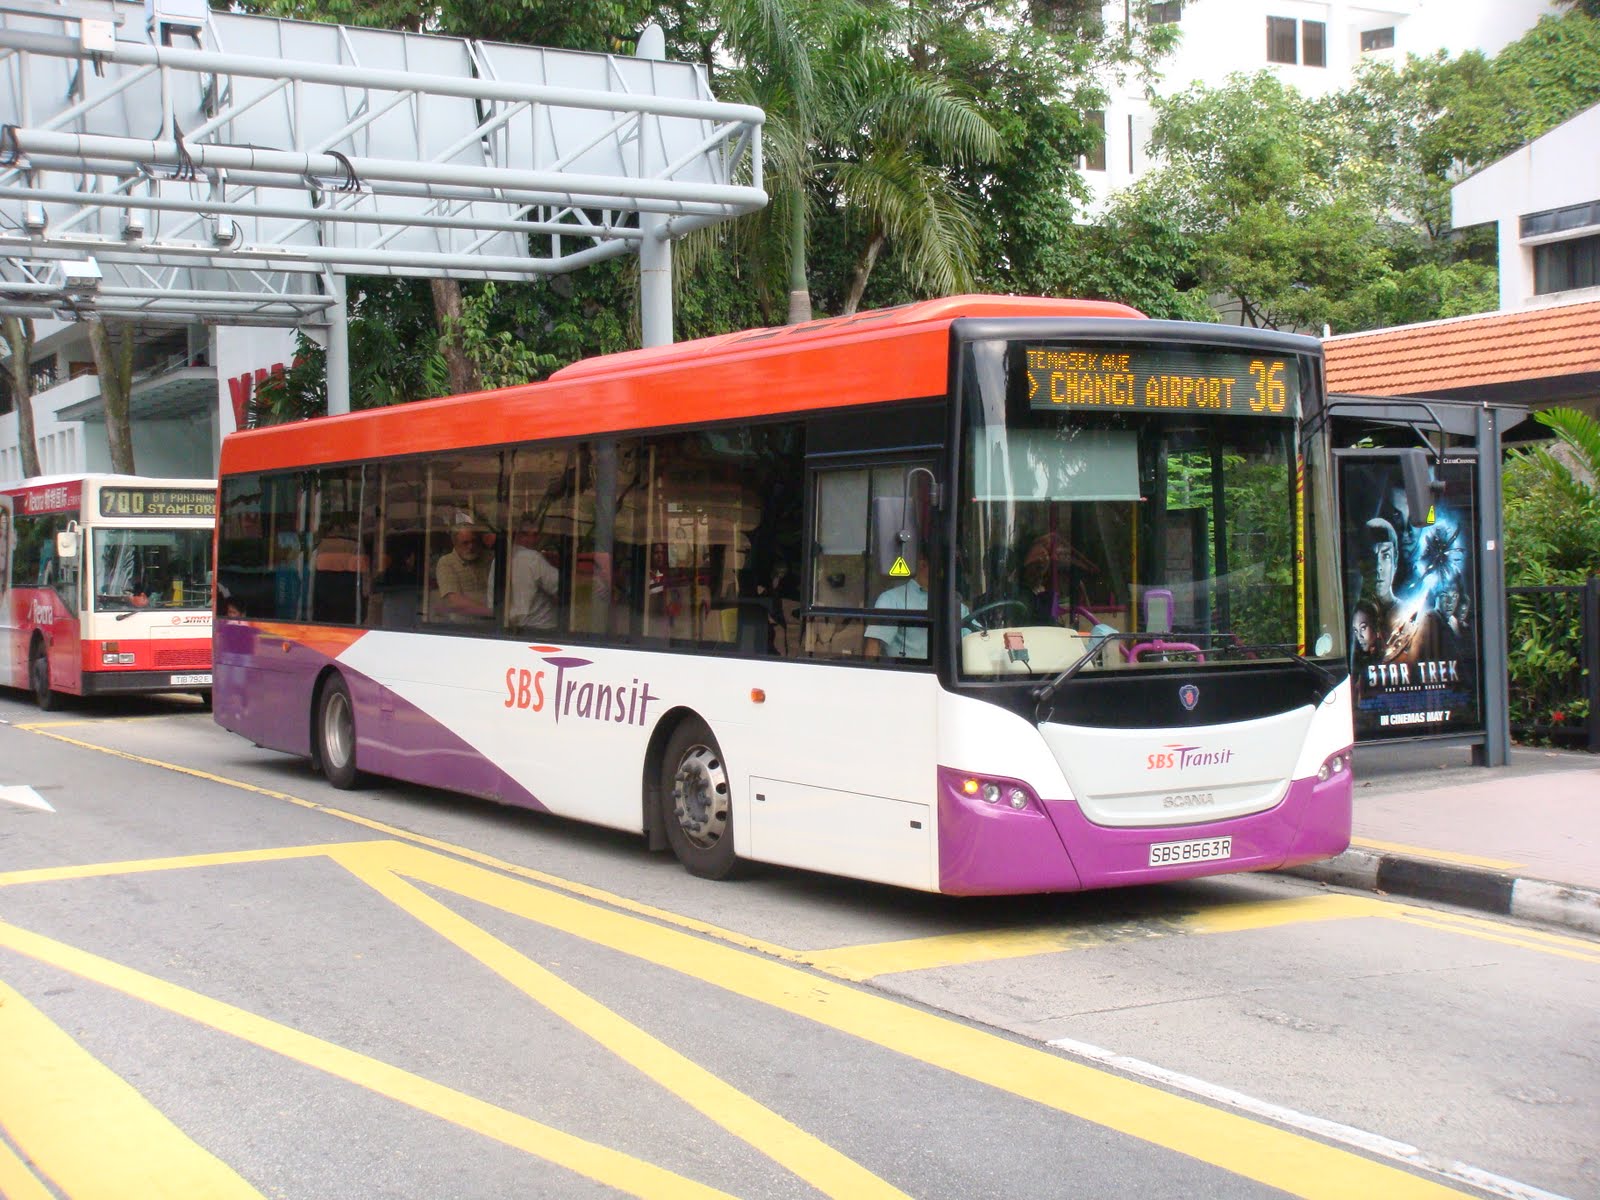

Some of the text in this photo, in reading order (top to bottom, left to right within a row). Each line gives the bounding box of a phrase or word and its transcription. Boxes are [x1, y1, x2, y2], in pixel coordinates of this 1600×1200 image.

[1027, 351, 1130, 372] TEMASEK AVE
[1051, 372, 1236, 408] CHANGI AIRPORT
[1250, 360, 1285, 412] 36
[103, 491, 144, 513] 700
[152, 493, 166, 502] BT
[1367, 660, 1459, 686] STAR TREK
[505, 657, 661, 725] SBS Transit
[1380, 710, 1451, 726] IN CINEMAS MAY 7
[1147, 746, 1235, 770] SBS Transit
[1163, 793, 1215, 808] SCANIA
[1152, 840, 1231, 863] SBS8563R
